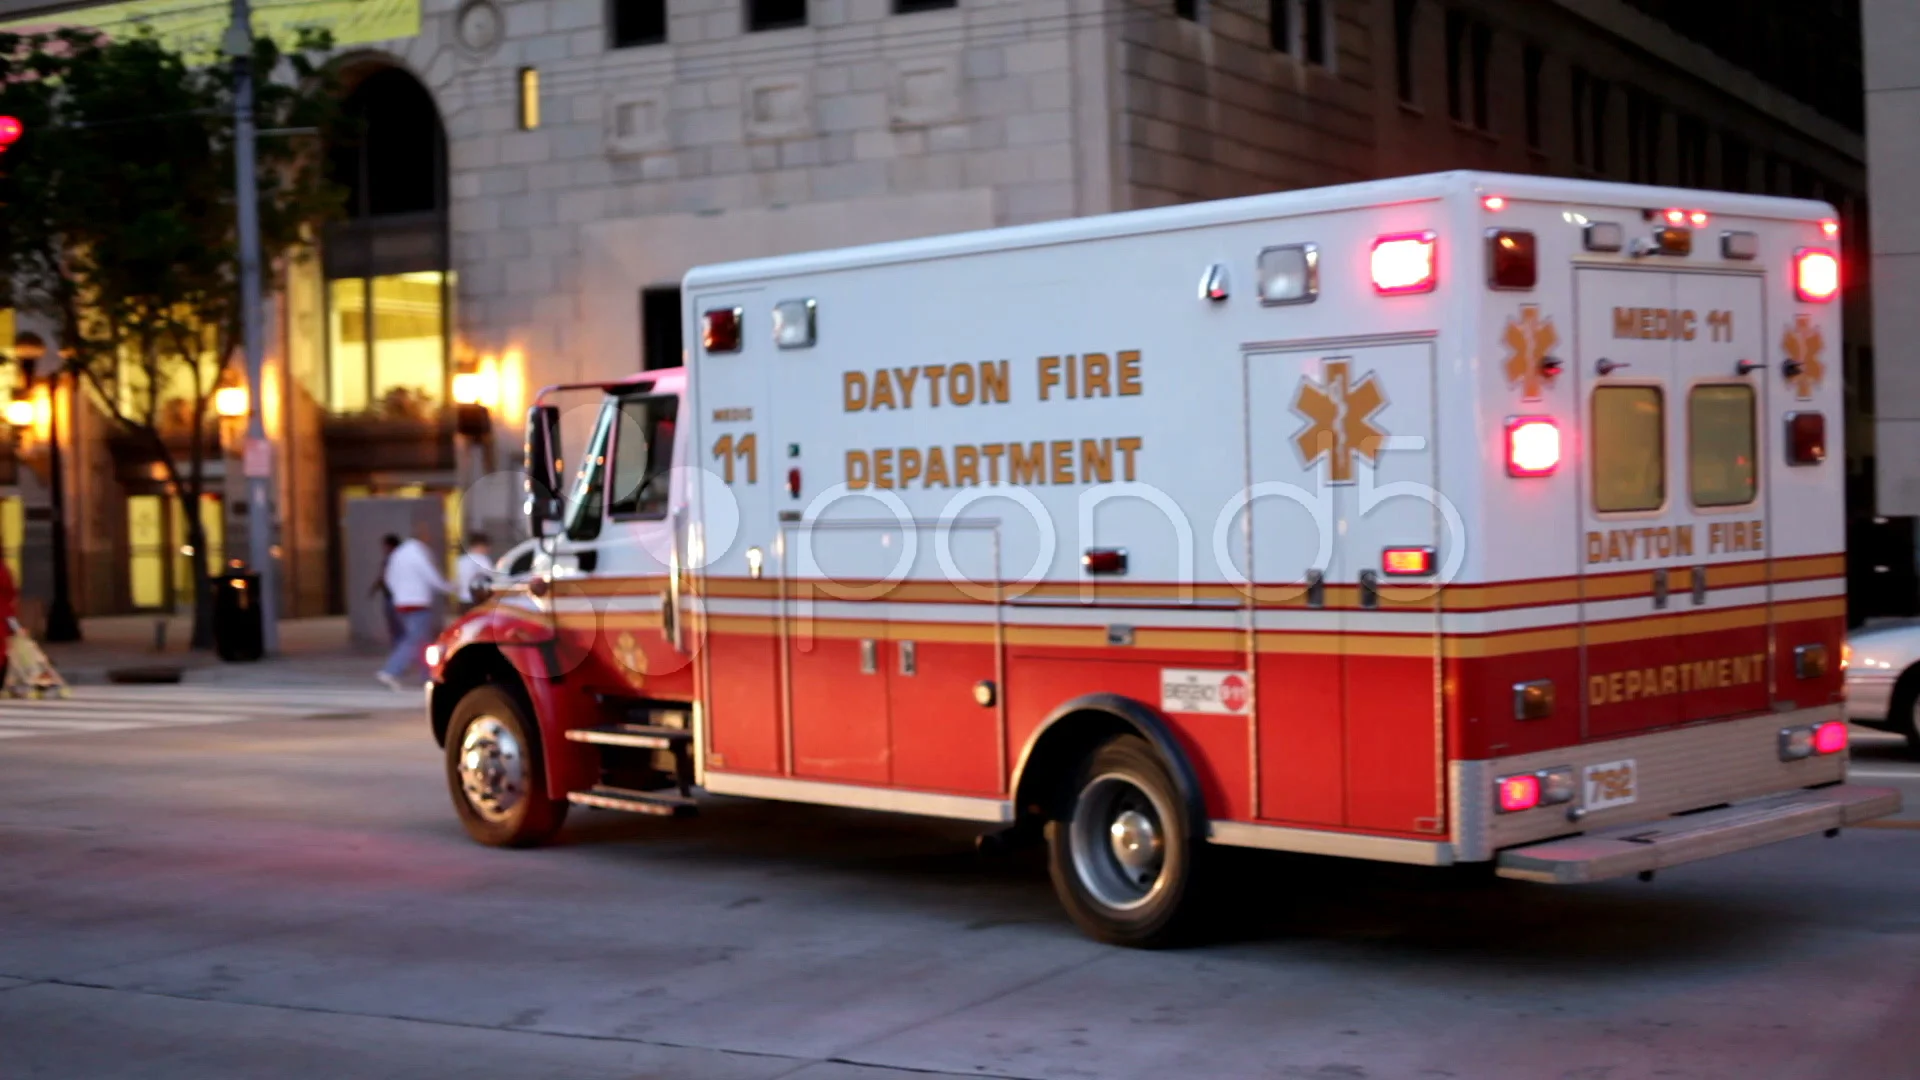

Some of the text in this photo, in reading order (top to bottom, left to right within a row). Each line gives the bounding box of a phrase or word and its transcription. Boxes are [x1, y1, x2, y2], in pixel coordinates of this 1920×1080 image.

[1613, 306, 1733, 342] MEDIC 11
[843, 350, 1142, 412] DAYTON FIRE
[713, 432, 757, 484] 11
[845, 436, 1142, 490] DEPARTMENT
[1586, 520, 1763, 564] DAYTON FIRE
[1588, 653, 1766, 706] DEPARTMENT
[1590, 766, 1632, 803] 792
